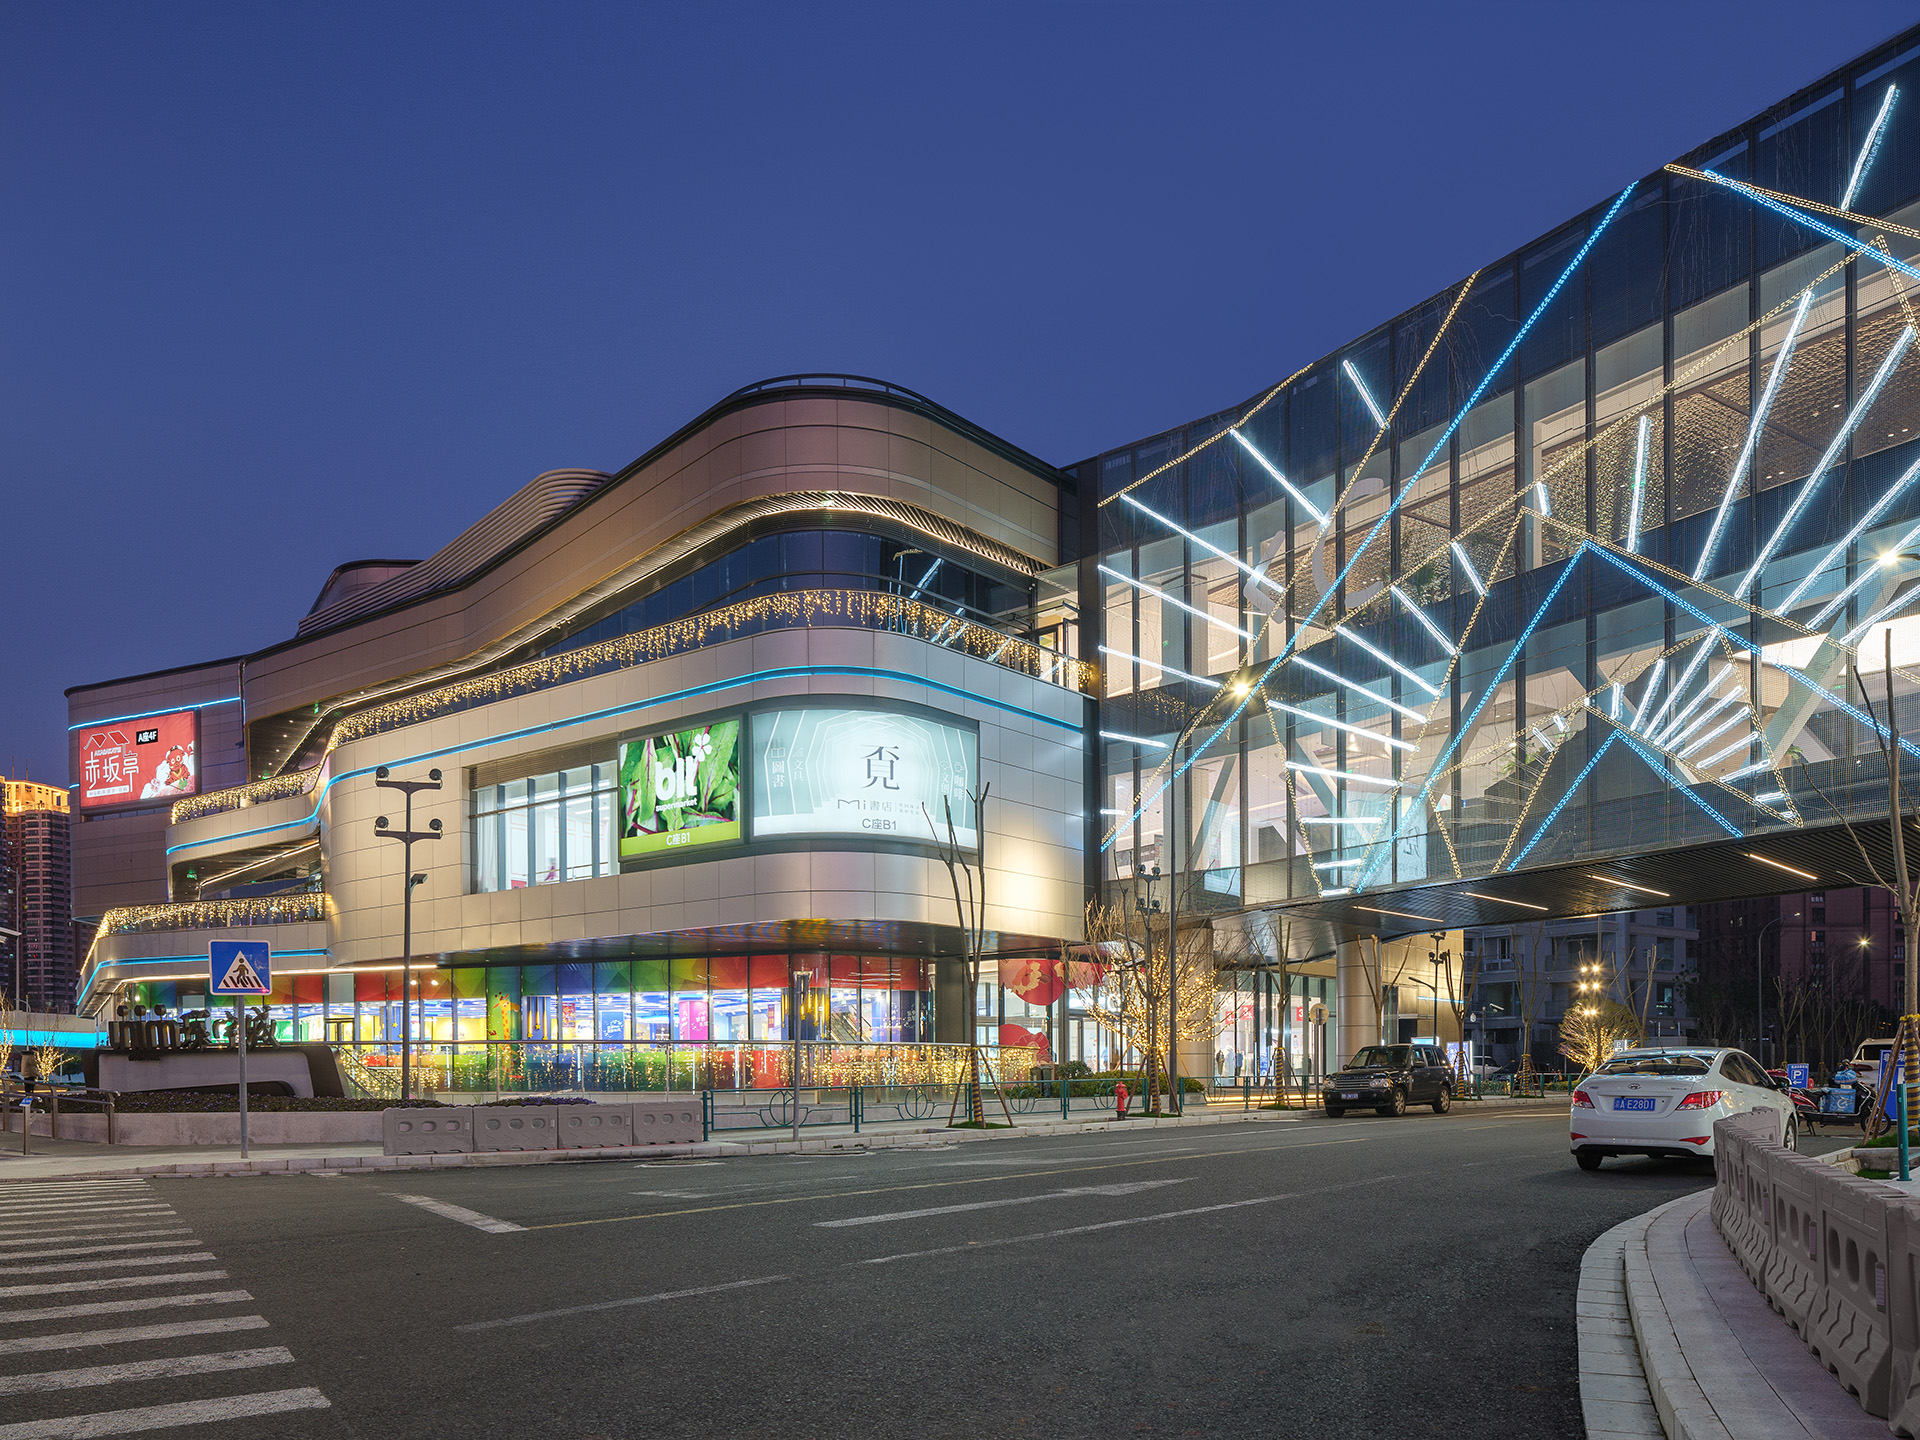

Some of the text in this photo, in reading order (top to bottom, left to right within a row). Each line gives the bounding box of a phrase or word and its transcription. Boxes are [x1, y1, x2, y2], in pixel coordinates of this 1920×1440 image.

[85, 750, 139, 792] 赤坂亭
[655, 798, 698, 812] supermarket
[862, 818, 897, 831] C座B1
[666, 832, 690, 846] C座B1
[1793, 1070, 1802, 1079] P
